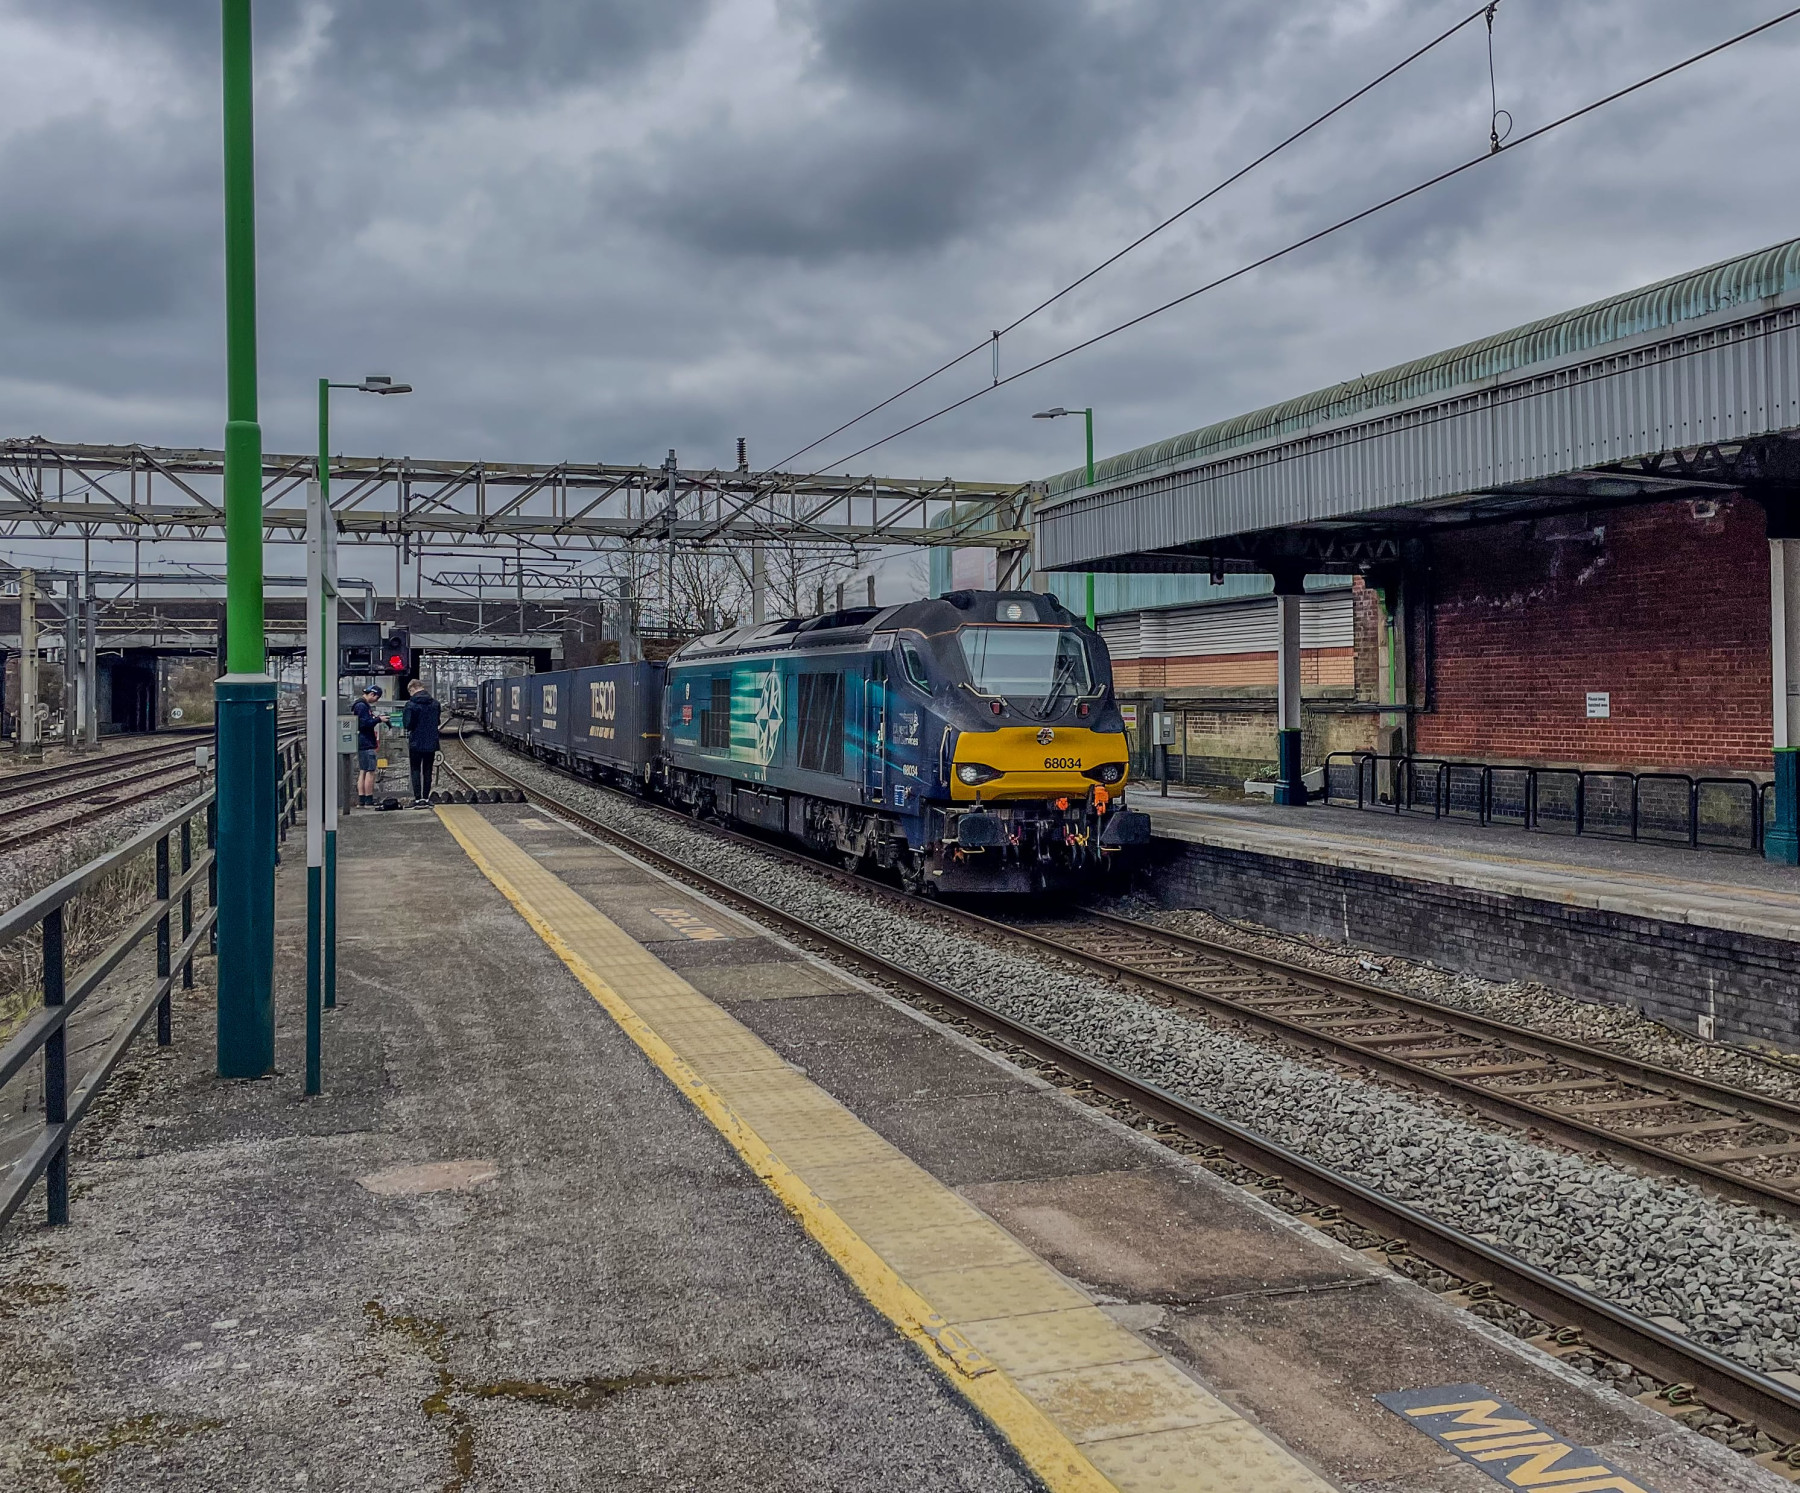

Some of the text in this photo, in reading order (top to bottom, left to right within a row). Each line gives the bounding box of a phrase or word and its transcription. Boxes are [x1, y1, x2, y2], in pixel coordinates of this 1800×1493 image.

[590, 681, 616, 720] TESCO
[1044, 757, 1082, 769] 68034
[903, 764, 919, 777] 68034
